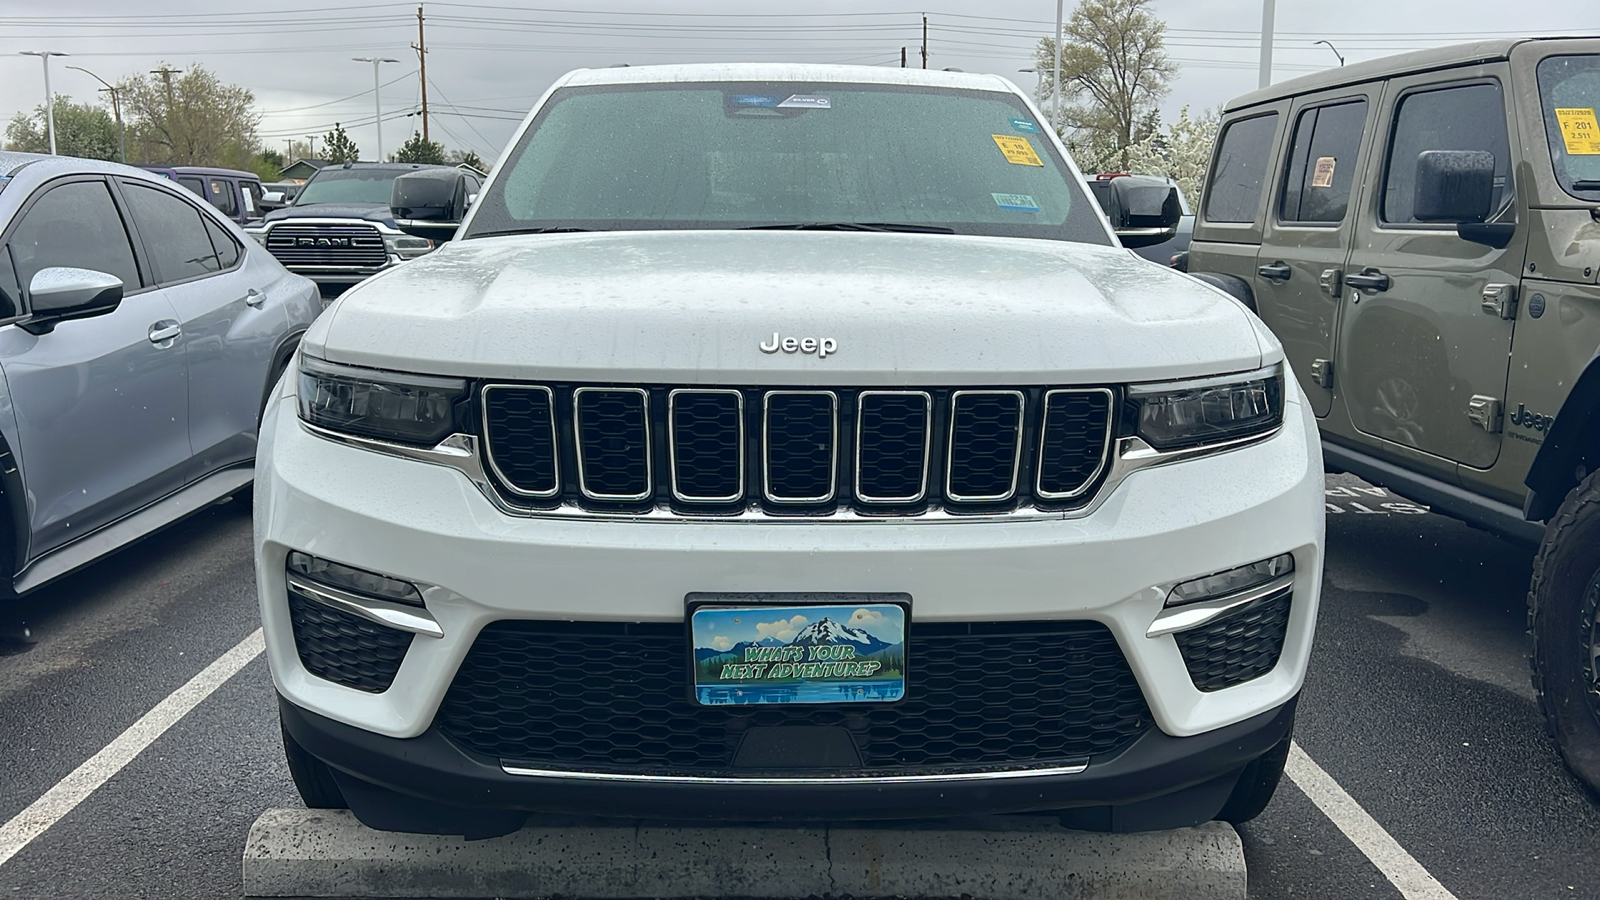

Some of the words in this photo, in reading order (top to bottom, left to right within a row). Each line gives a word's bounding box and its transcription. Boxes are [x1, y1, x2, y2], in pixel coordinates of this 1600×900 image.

[299, 238, 348, 246] RAM
[759, 332, 838, 359] Jeep
[744, 645, 804, 663] WHAT'S
[809, 645, 856, 661] YOUR
[720, 663, 767, 680] NEXT
[768, 661, 881, 679] ADVENTURE?
